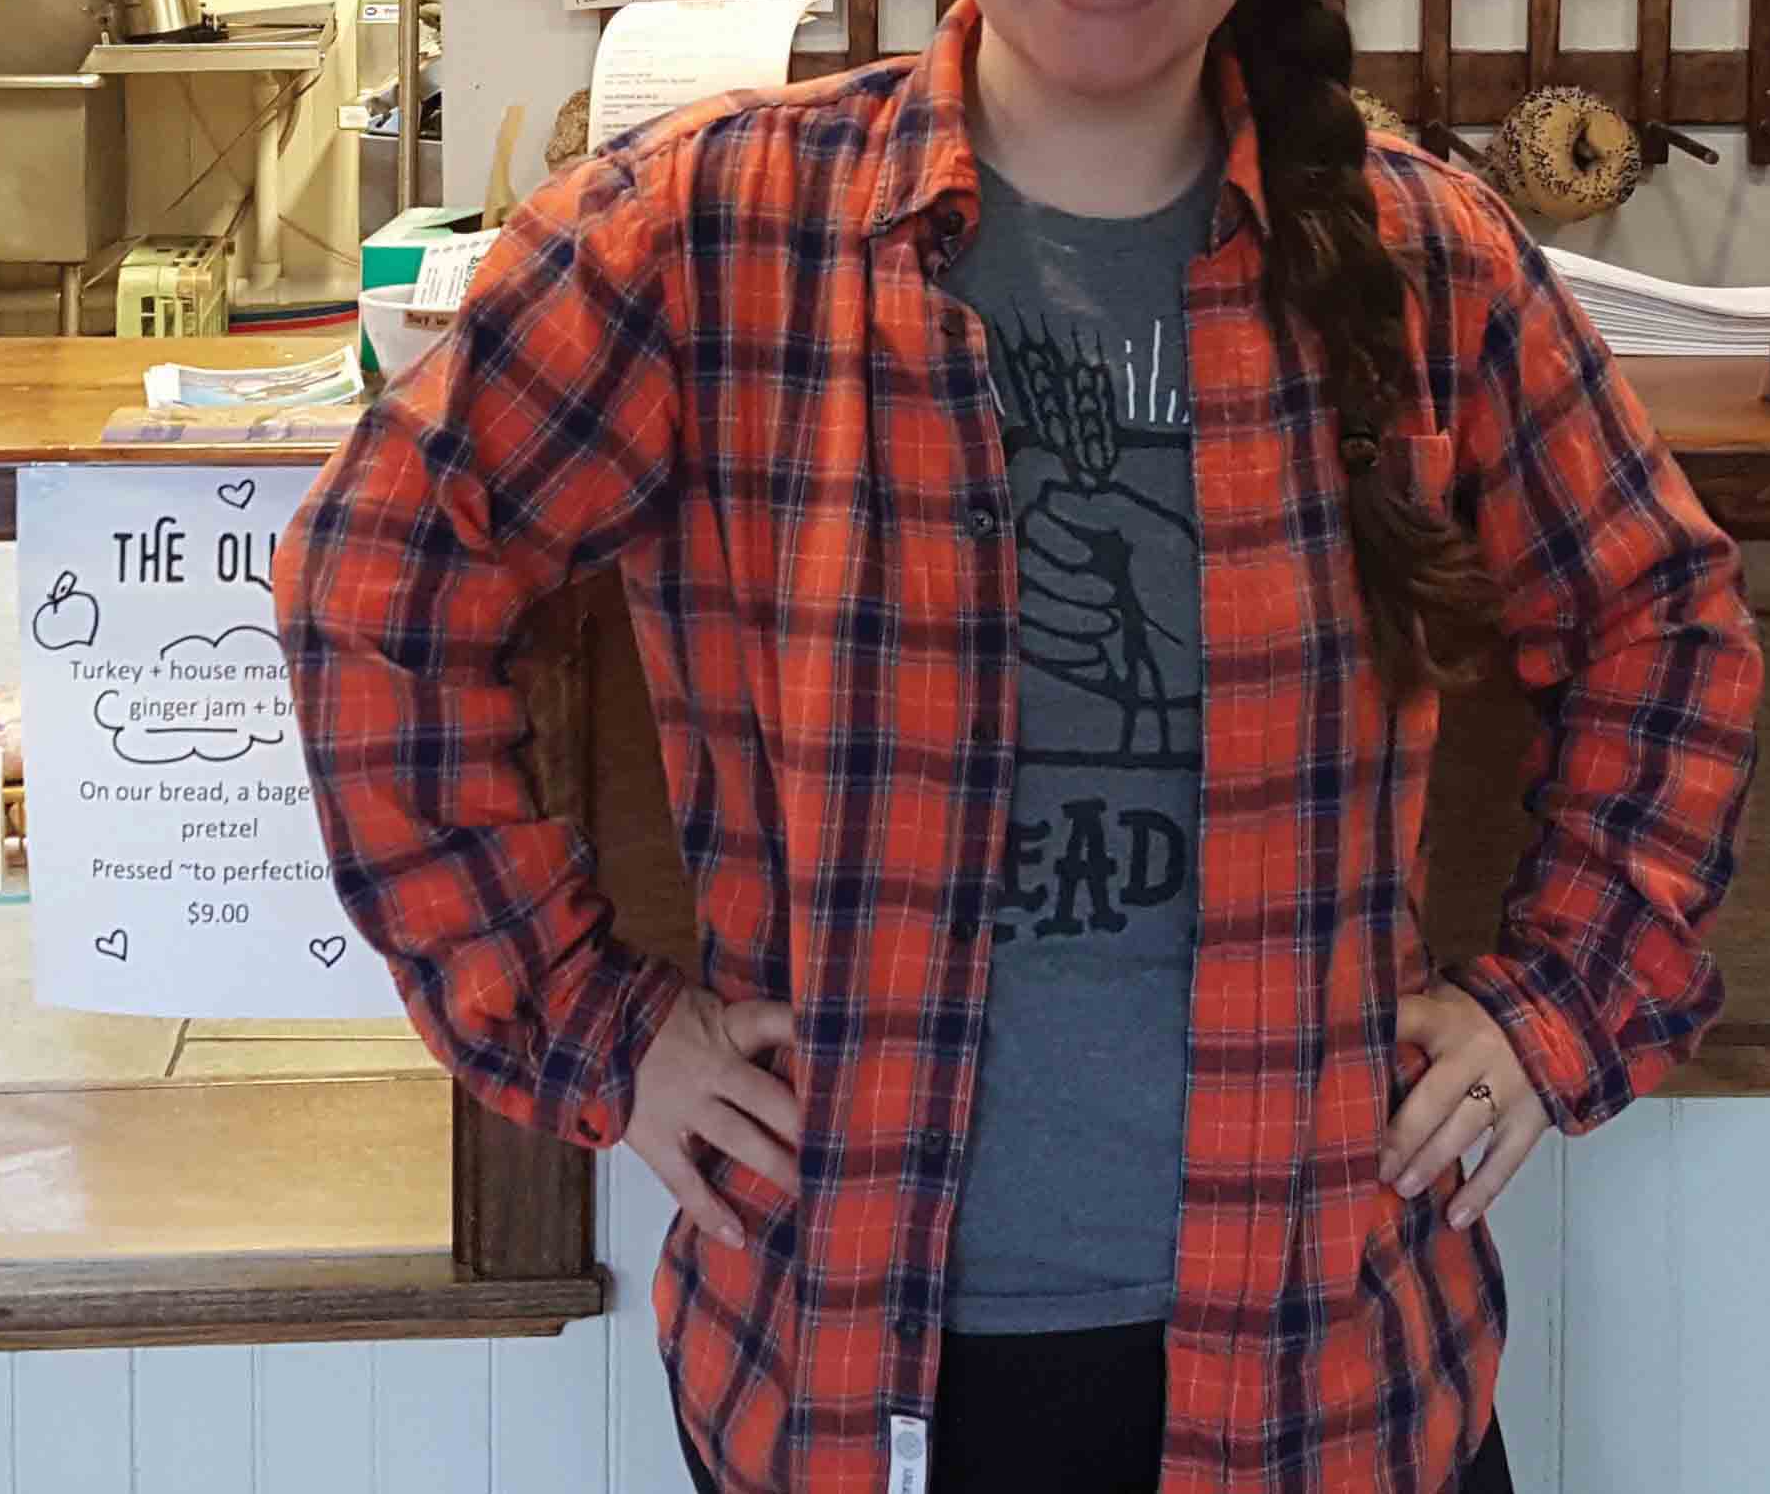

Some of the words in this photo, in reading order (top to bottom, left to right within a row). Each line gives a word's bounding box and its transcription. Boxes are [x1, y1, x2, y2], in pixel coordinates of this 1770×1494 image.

[111, 516, 186, 585] THE
[70, 659, 144, 684] Turkey
[170, 659, 238, 681] house
[129, 695, 197, 722] ginger
[204, 696, 246, 721] jam
[79, 780, 109, 802] On
[116, 785, 153, 802] our
[159, 781, 230, 805] bread,
[236, 785, 250, 802] a
[256, 781, 311, 806] bage
[181, 817, 259, 843] pretzel
[91, 857, 174, 880] Pressed
[999, 797, 1188, 942] EAD
[187, 900, 250, 926] $9.00
